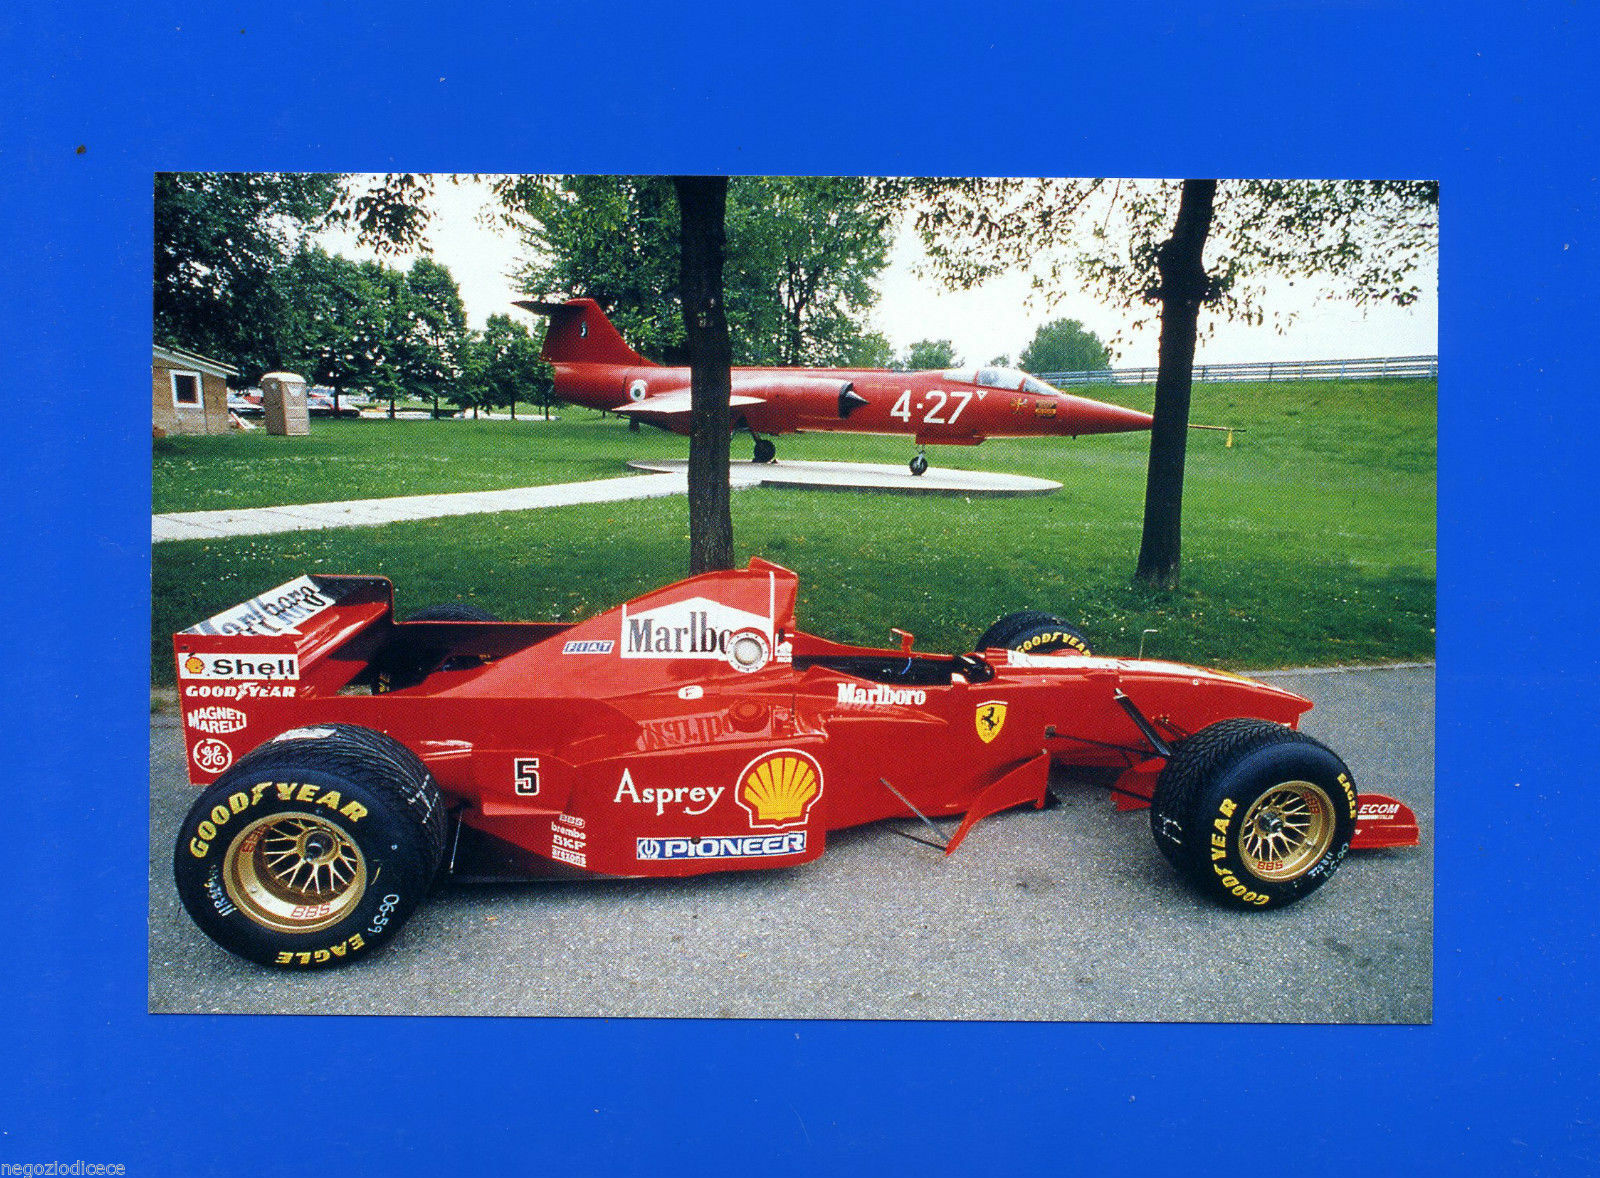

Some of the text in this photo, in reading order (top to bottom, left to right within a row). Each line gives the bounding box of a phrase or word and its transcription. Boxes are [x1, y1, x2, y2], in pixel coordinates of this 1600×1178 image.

[628, 611, 733, 655] Marlbo
[565, 641, 613, 653] FIAT
[213, 659, 295, 676] Shell
[837, 683, 927, 706] Marlboro
[514, 757, 540, 796] 5
[613, 767, 725, 816] Asprey
[1337, 773, 1357, 819] EAGLE
[1358, 803, 1400, 814] ECOM
[551, 821, 586, 840] brembo
[664, 832, 805, 858] PIONEER
[1257, 860, 1284, 871] BBS
[291, 902, 332, 919] BBS
[274, 933, 366, 965] EAGLE
